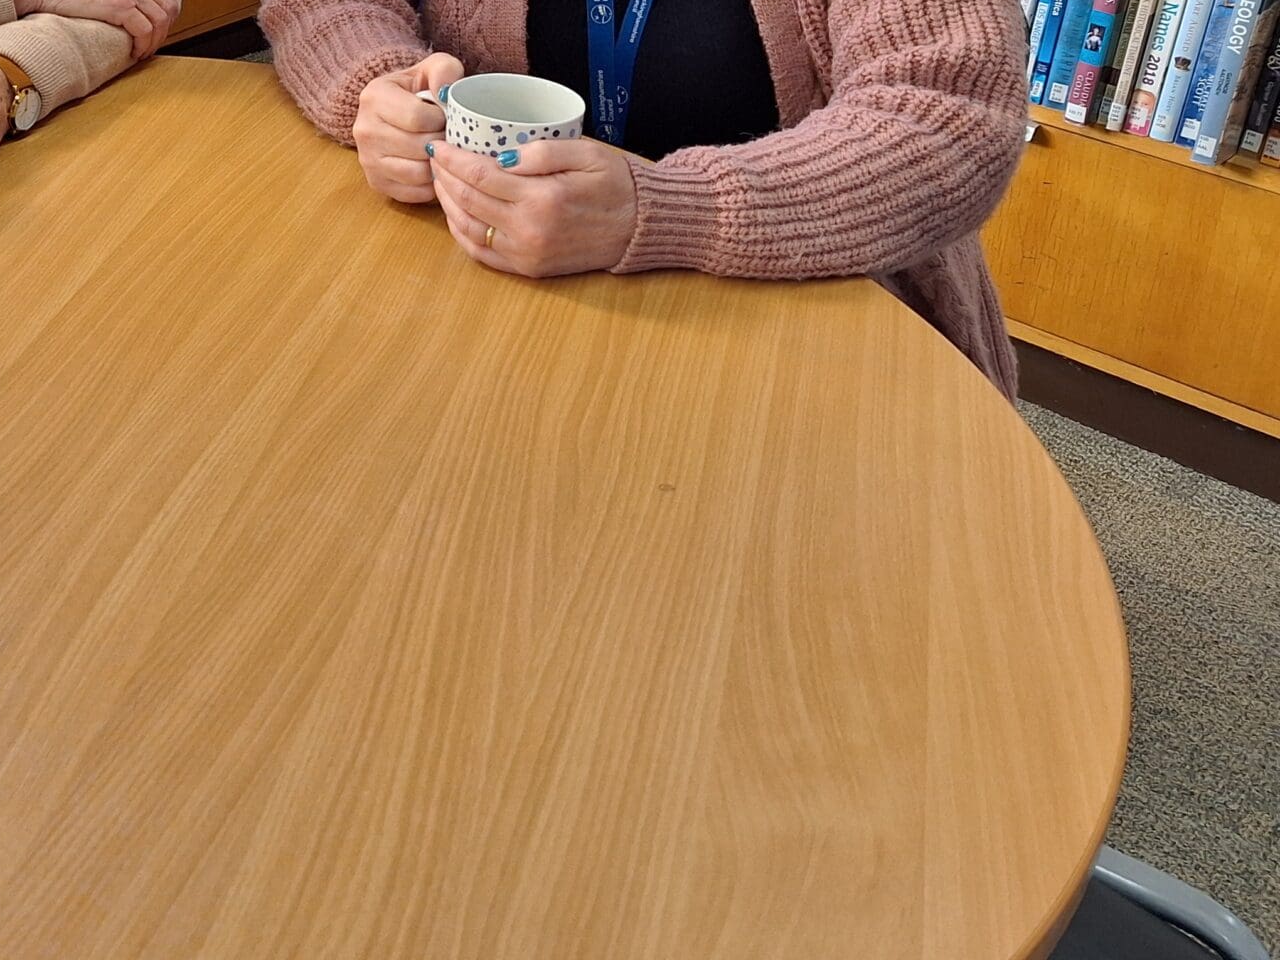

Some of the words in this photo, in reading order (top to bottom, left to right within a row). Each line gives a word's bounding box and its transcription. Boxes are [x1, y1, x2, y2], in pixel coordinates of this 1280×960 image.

[1151, 1, 1179, 52] Names
[1142, 54, 1161, 86] 2018
[598, 69, 606, 122] Buckinghamshire
[1071, 74, 1085, 99] GOLD
[607, 99, 615, 122] Council
